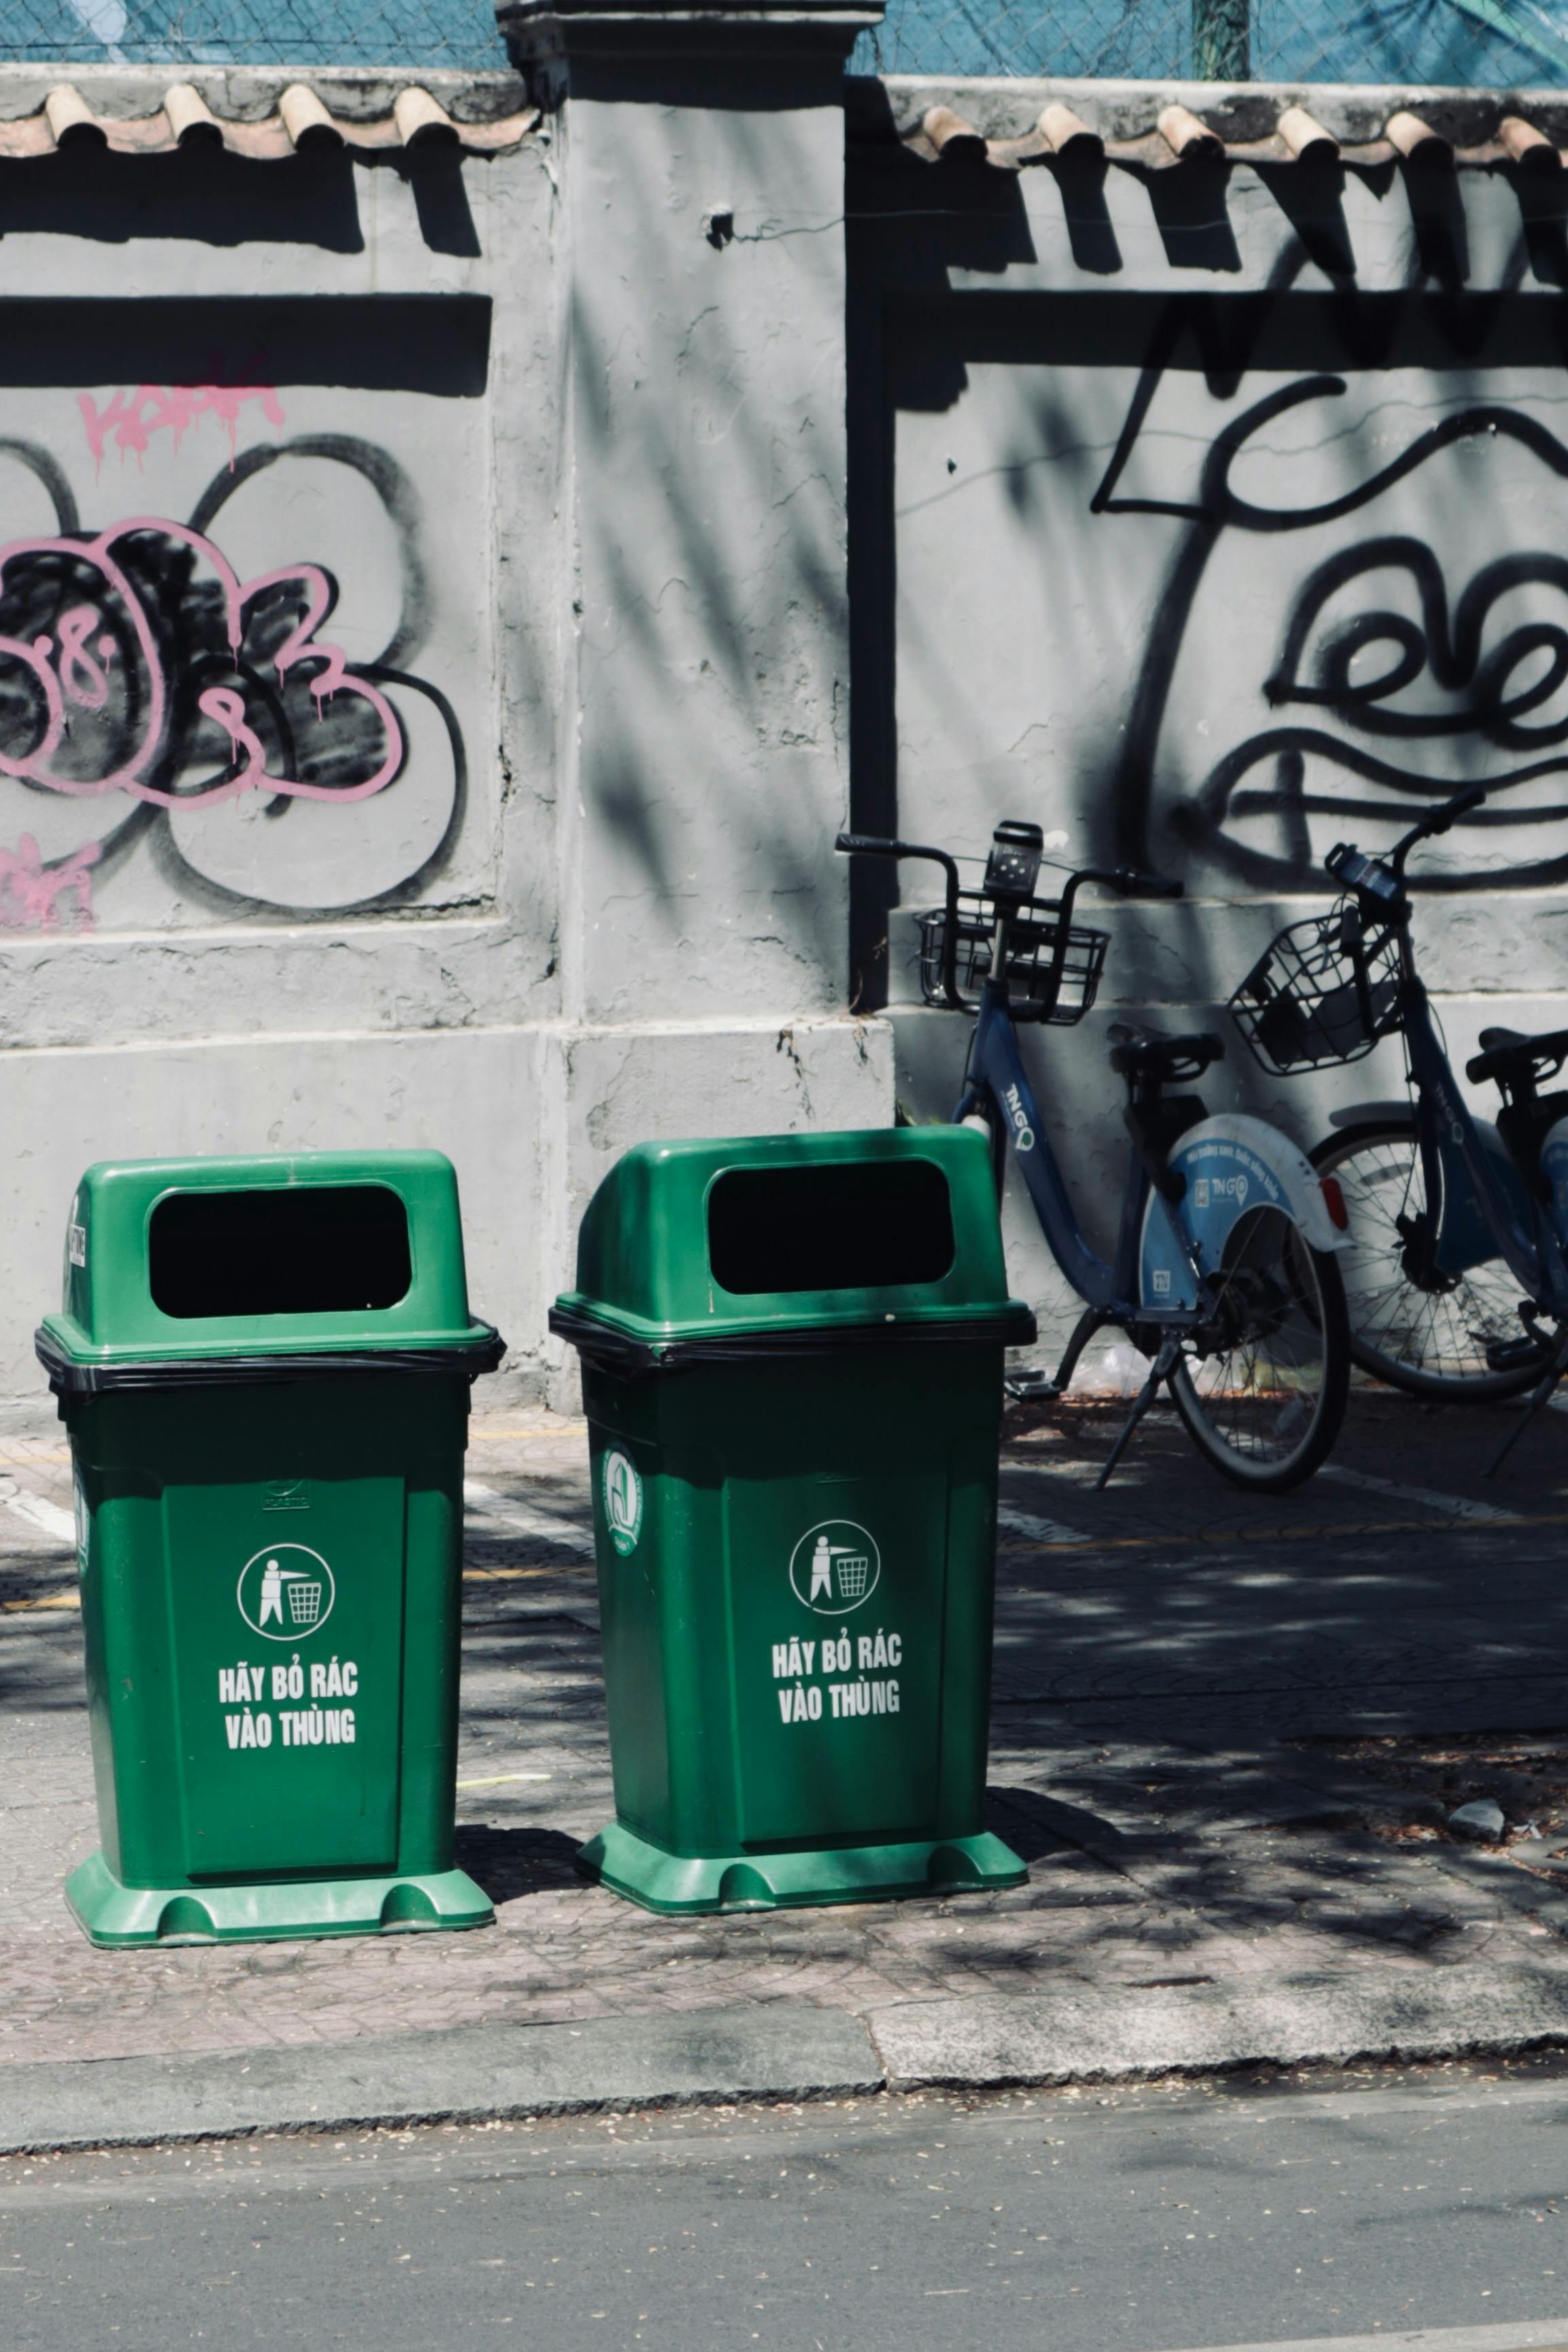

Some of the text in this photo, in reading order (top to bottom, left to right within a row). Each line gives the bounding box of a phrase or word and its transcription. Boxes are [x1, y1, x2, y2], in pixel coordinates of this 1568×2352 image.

[1006, 1082, 1035, 1152] TNGO
[1212, 1174, 1249, 1207] TNGO
[772, 1627, 903, 1678] HÃY BỎ RÁC
[218, 1653, 358, 1703] HÃY BỎ RÁC
[778, 1675, 900, 1723] VÀO THÙNG
[224, 1703, 356, 1749] VÀO THÙNG
